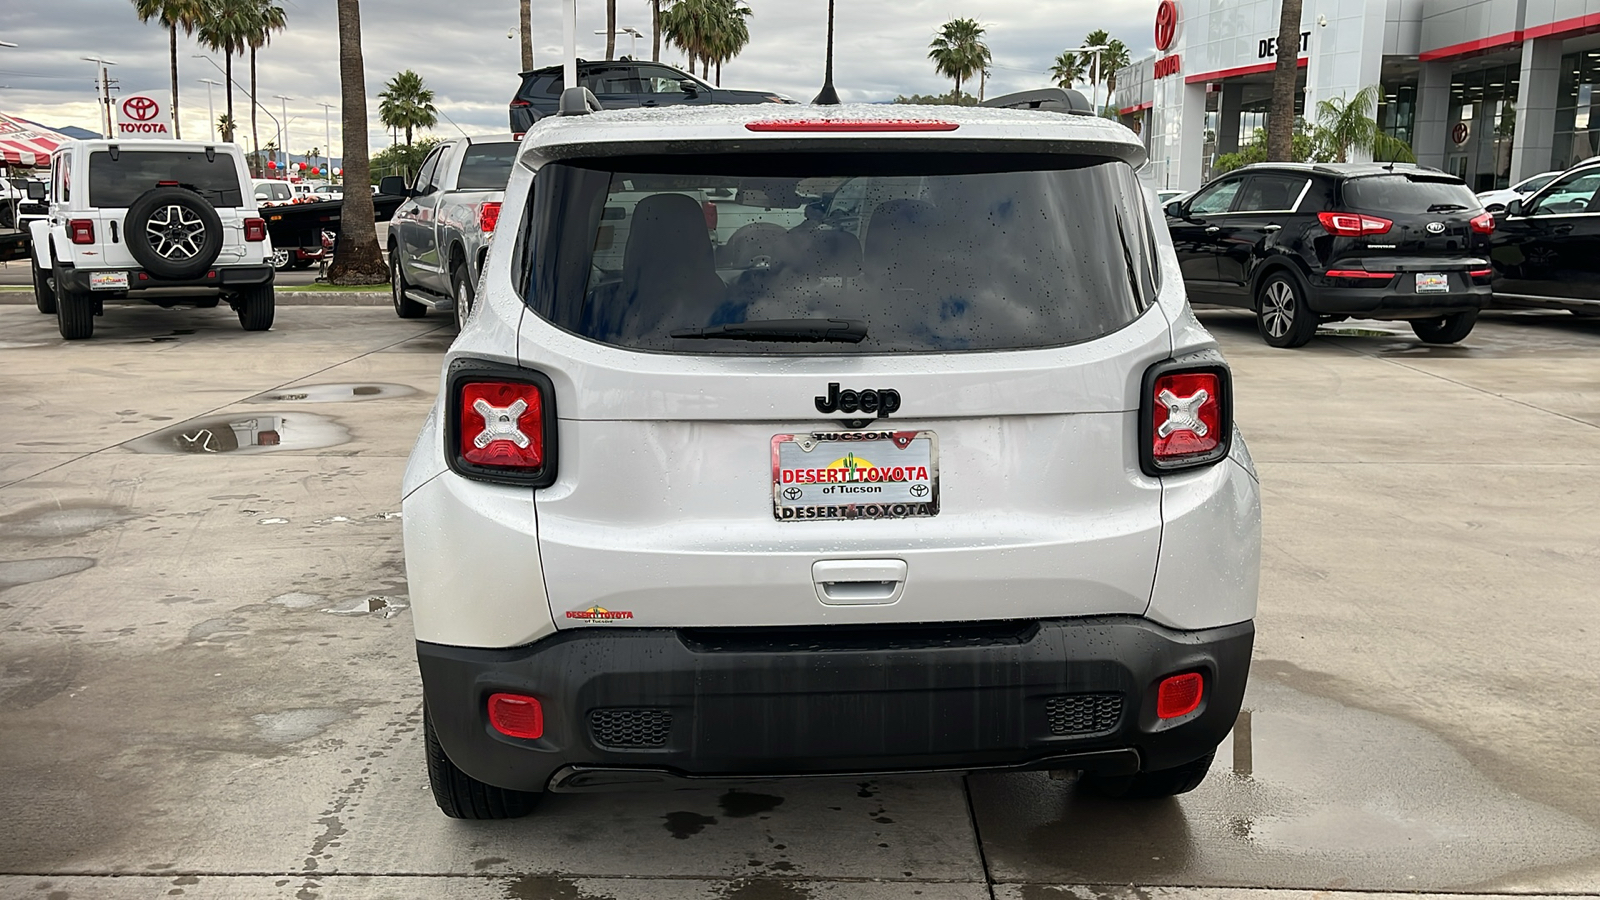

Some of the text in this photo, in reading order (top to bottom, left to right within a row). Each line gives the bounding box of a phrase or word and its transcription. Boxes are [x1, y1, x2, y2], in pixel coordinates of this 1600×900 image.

[1258, 31, 1311, 58] DET
[118, 123, 167, 133] TOYOTA
[815, 382, 901, 418] Jeep
[814, 432, 893, 441] TUCSON
[782, 466, 928, 484] DESERT TOYOTA
[822, 485, 882, 494] of Tucson
[782, 504, 929, 518] DESERT TOYOTA
[566, 611, 634, 619] DESERT TOYOTA
